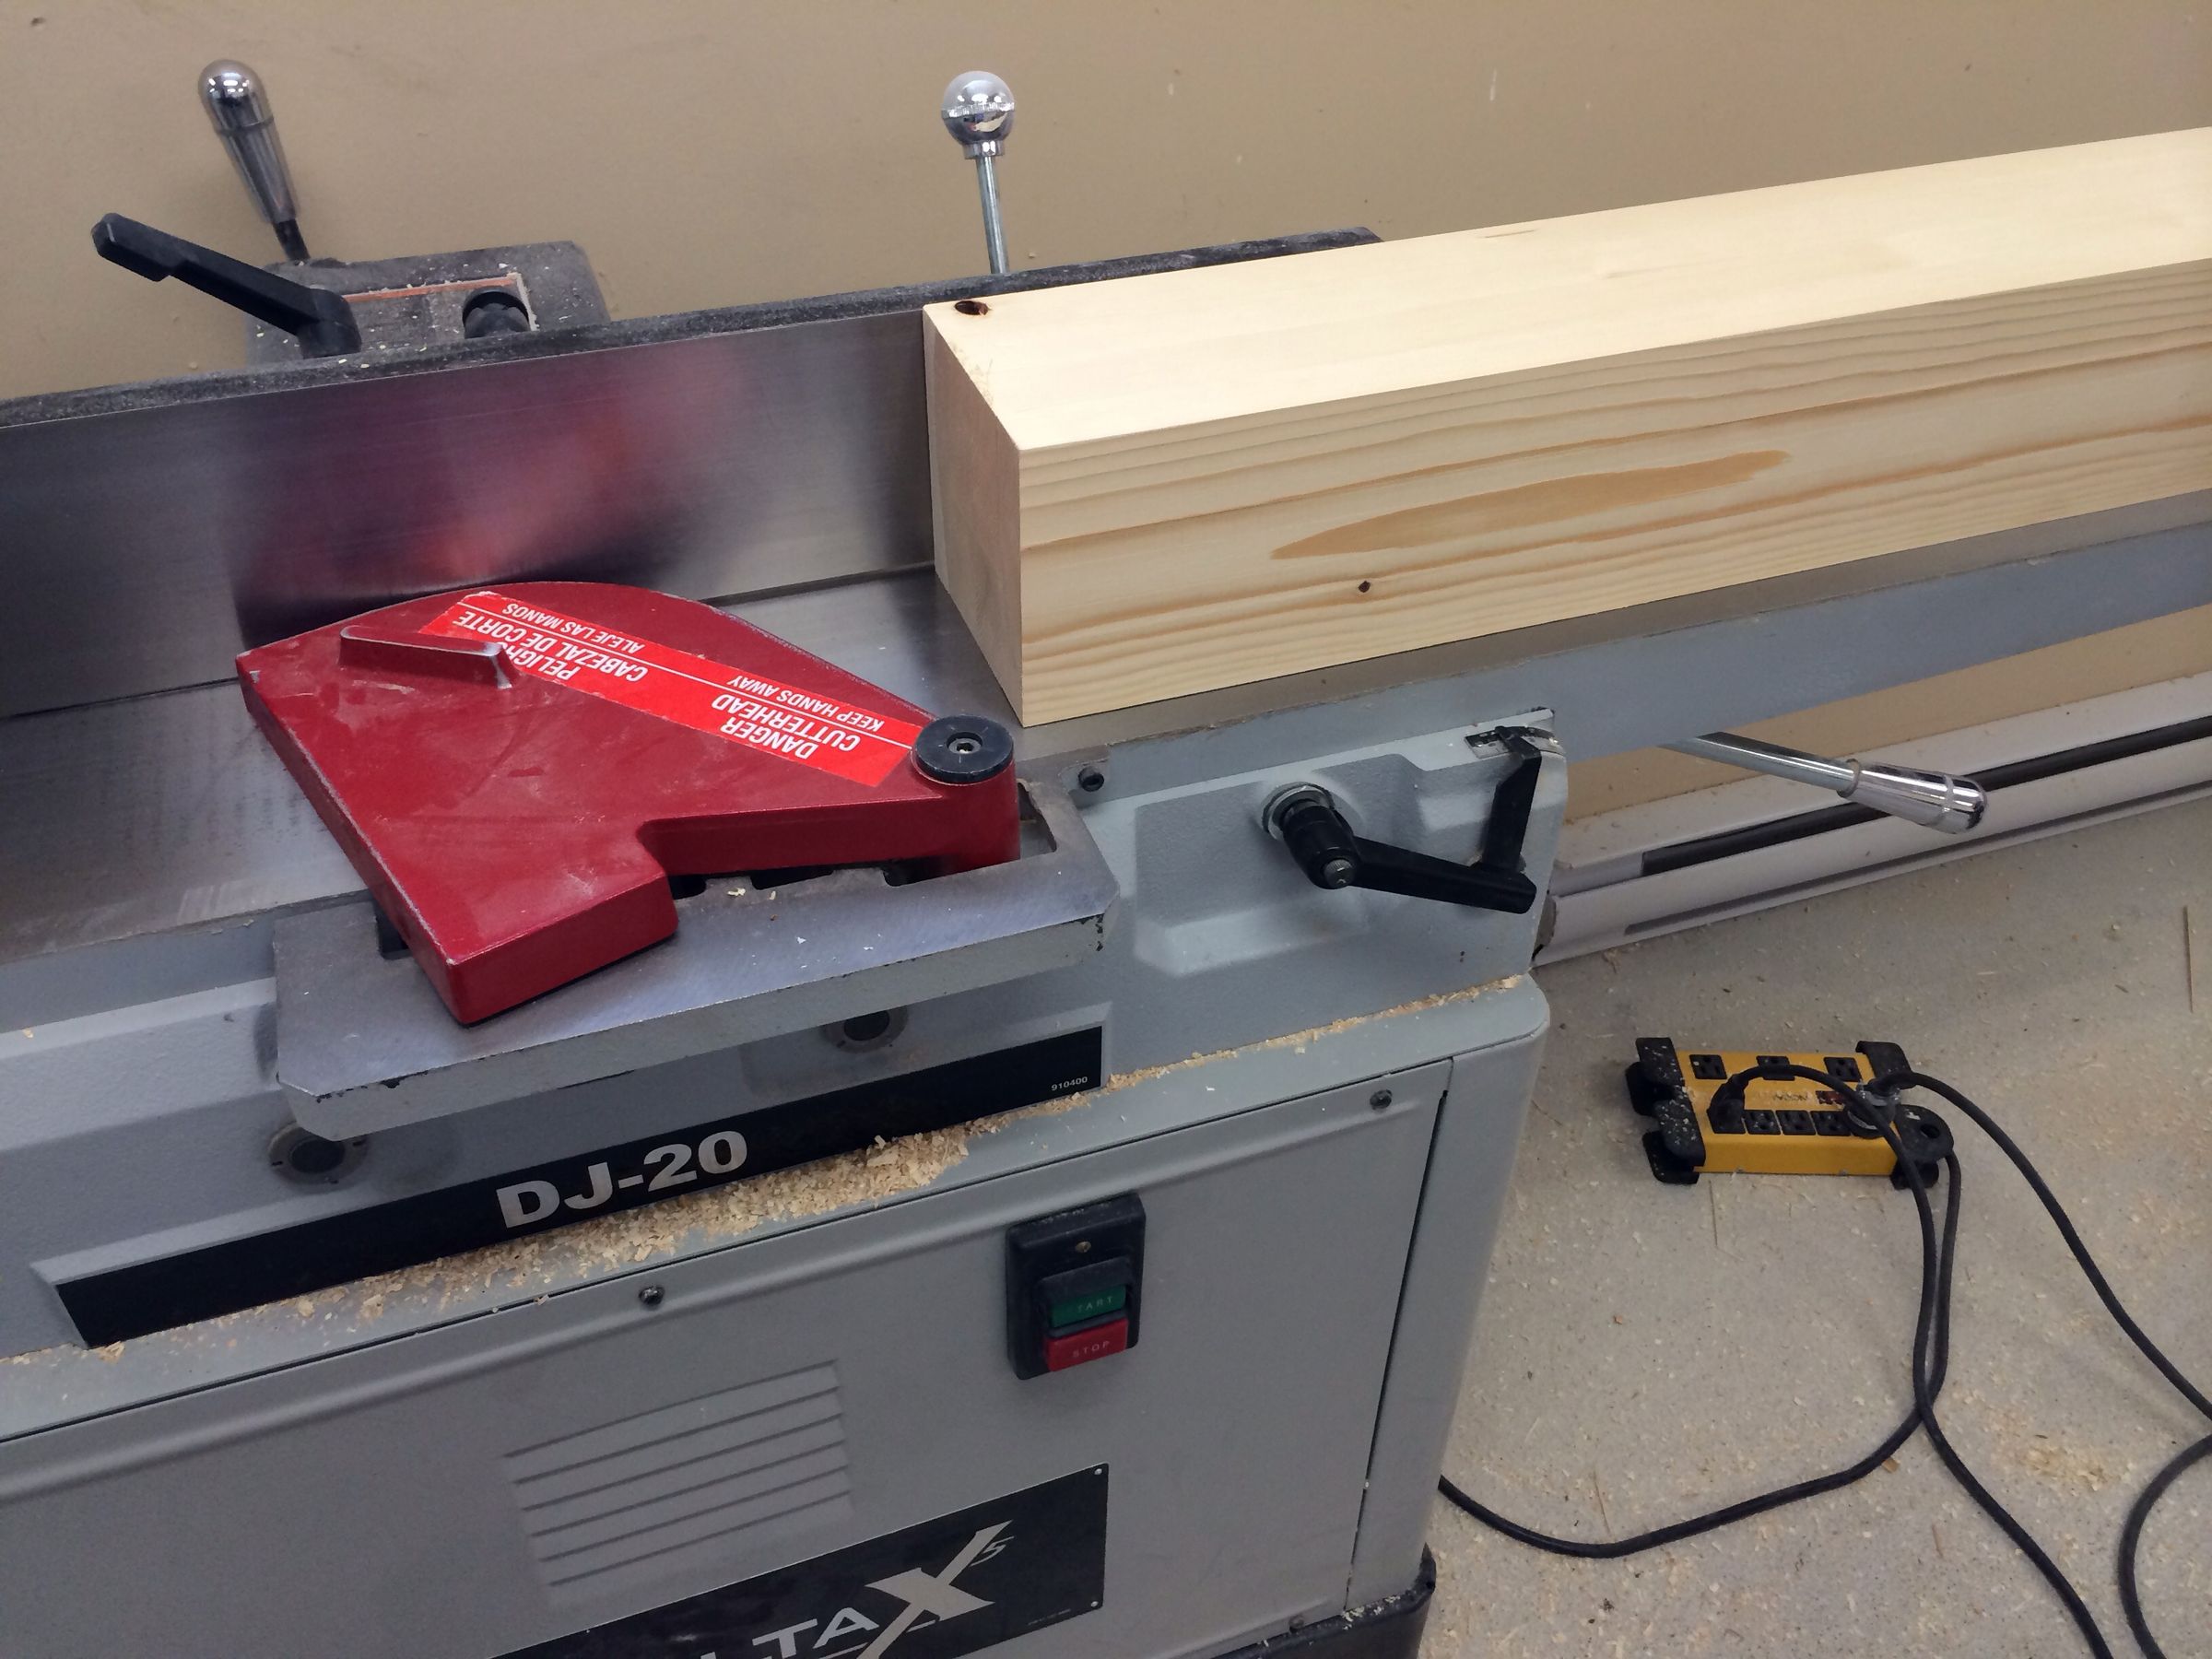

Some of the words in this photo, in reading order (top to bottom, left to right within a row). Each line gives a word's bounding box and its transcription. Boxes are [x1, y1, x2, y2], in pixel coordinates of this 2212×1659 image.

[453, 610, 526, 643] CORTE
[502, 603, 563, 629] MANOS
[521, 632, 559, 653] DE
[560, 621, 597, 640] LAS
[592, 631, 645, 653] ALEJE
[497, 641, 581, 681] PELIGR
[555, 642, 649, 682] CABEZAL
[727, 675, 780, 695] AWAY
[776, 689, 840, 716] HANDS
[712, 694, 861, 752] CUTTERHEAD
[836, 713, 885, 732] KEEP
[720, 716, 819, 759] DANGER
[1051, 1076, 1088, 1091] 910400
[496, 1130, 747, 1229] DJ-20
[1070, 1297, 1113, 1313] TART
[1073, 1340, 1111, 1358] STOP
